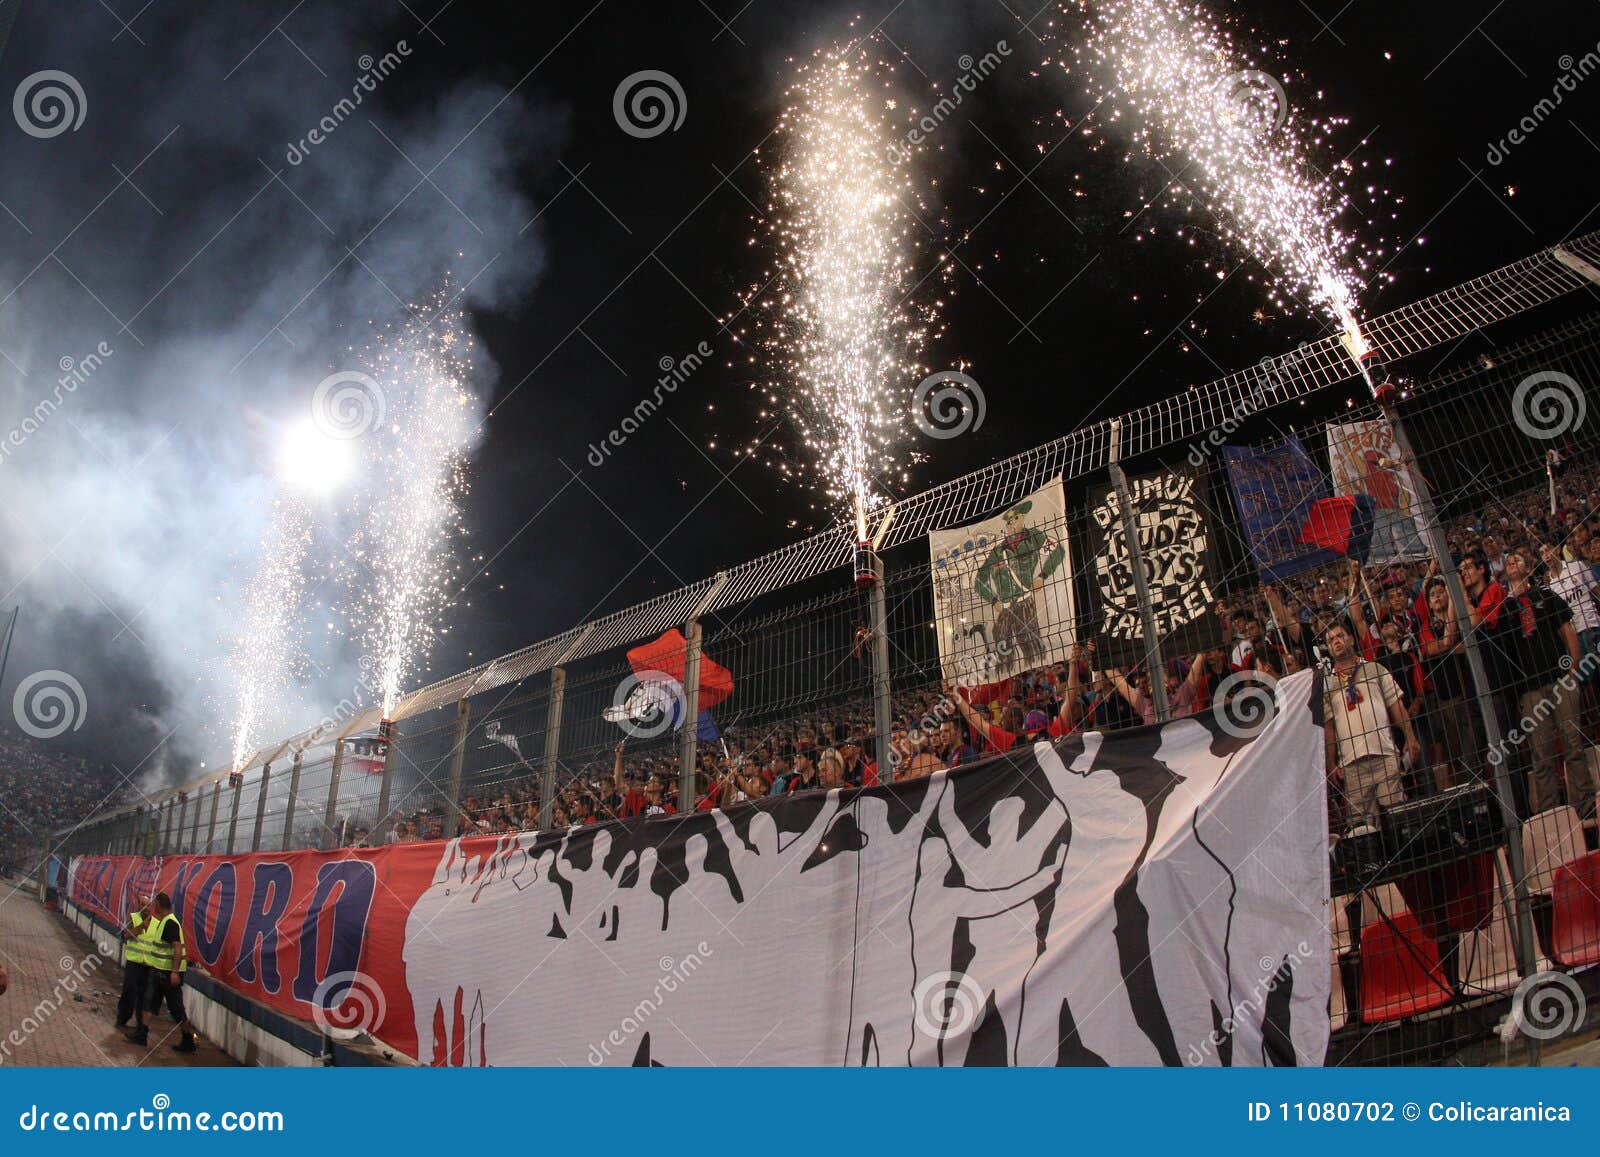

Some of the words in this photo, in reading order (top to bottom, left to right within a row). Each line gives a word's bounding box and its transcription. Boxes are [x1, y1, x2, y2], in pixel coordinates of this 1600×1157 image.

[1111, 515, 1198, 559] RUDE
[1111, 551, 1198, 595] BOYS
[171, 859, 376, 1010] NORD
